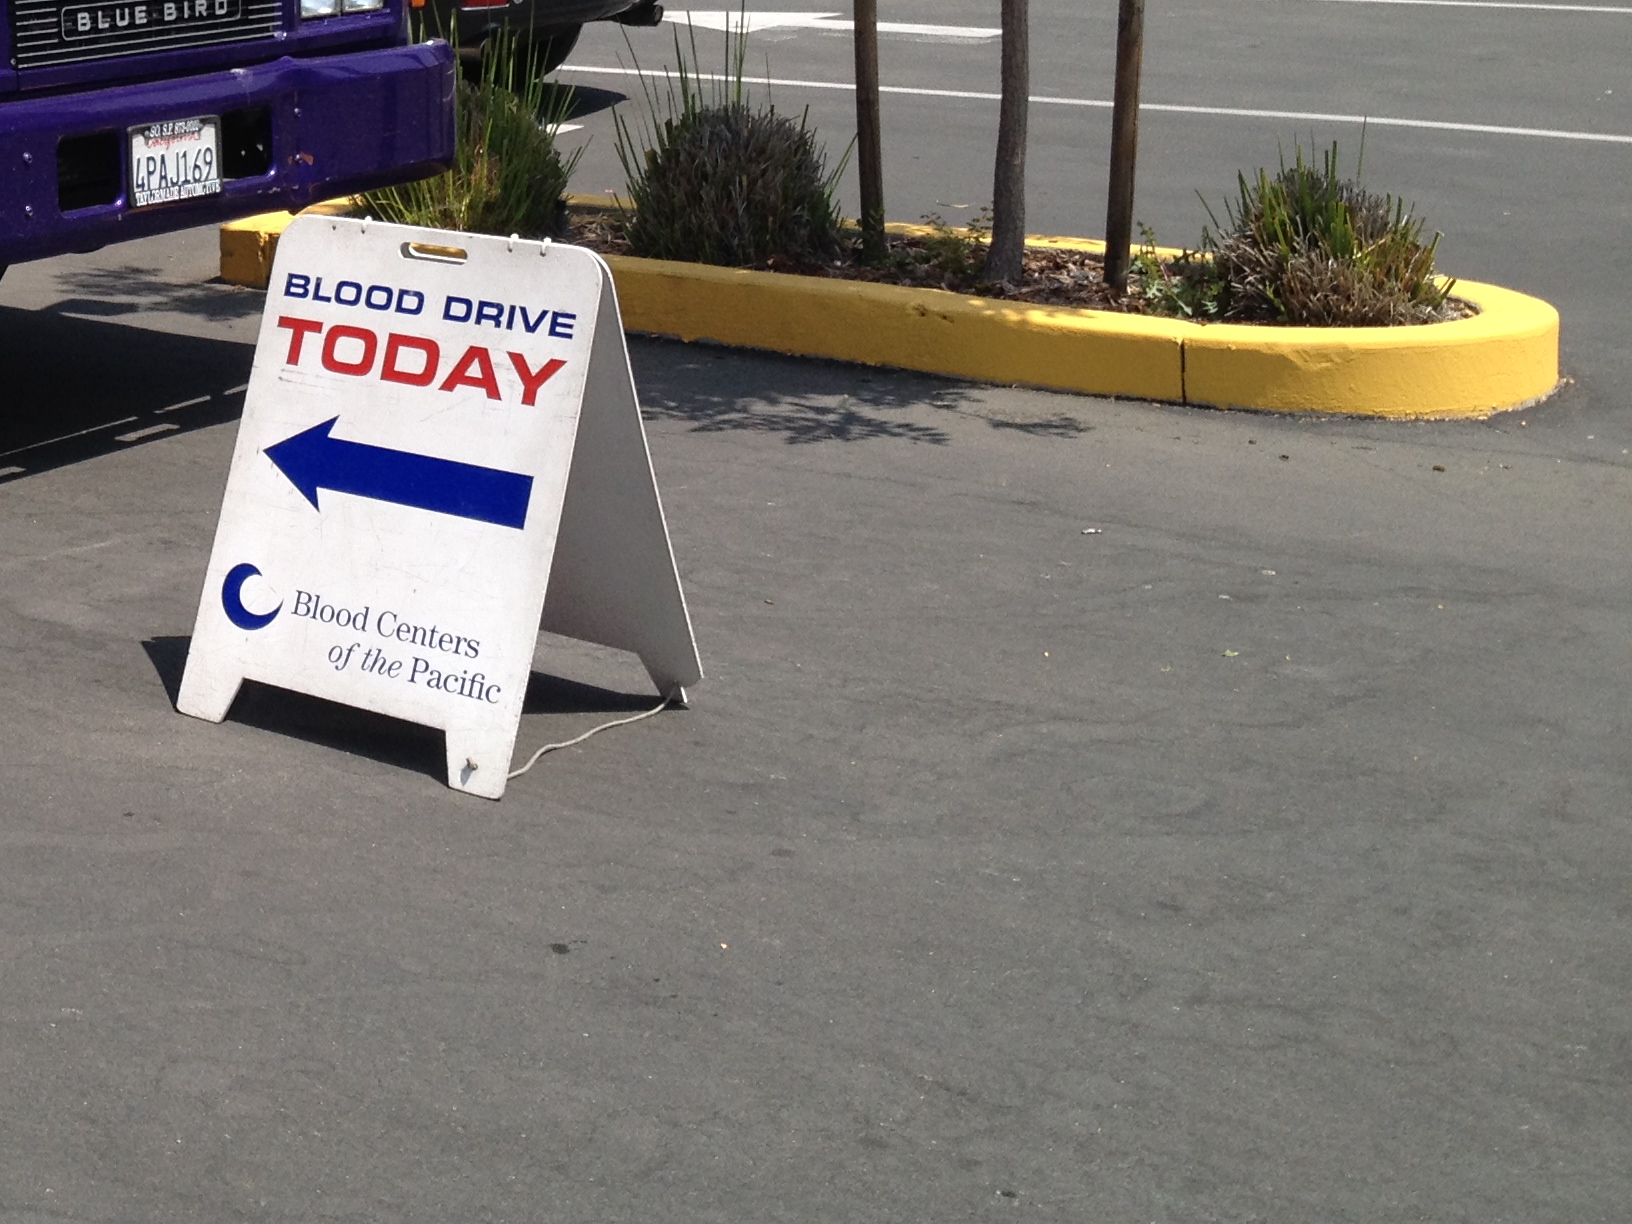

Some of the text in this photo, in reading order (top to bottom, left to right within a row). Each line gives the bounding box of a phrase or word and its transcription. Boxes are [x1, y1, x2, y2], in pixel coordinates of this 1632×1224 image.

[76, 5, 148, 32] BLUE
[135, 146, 214, 191] 4PAJ169
[283, 272, 577, 340] BLOOD DRIVE
[277, 316, 567, 407] TODAY
[290, 589, 480, 658] Blood Centers
[327, 643, 502, 705] of the Pacific
